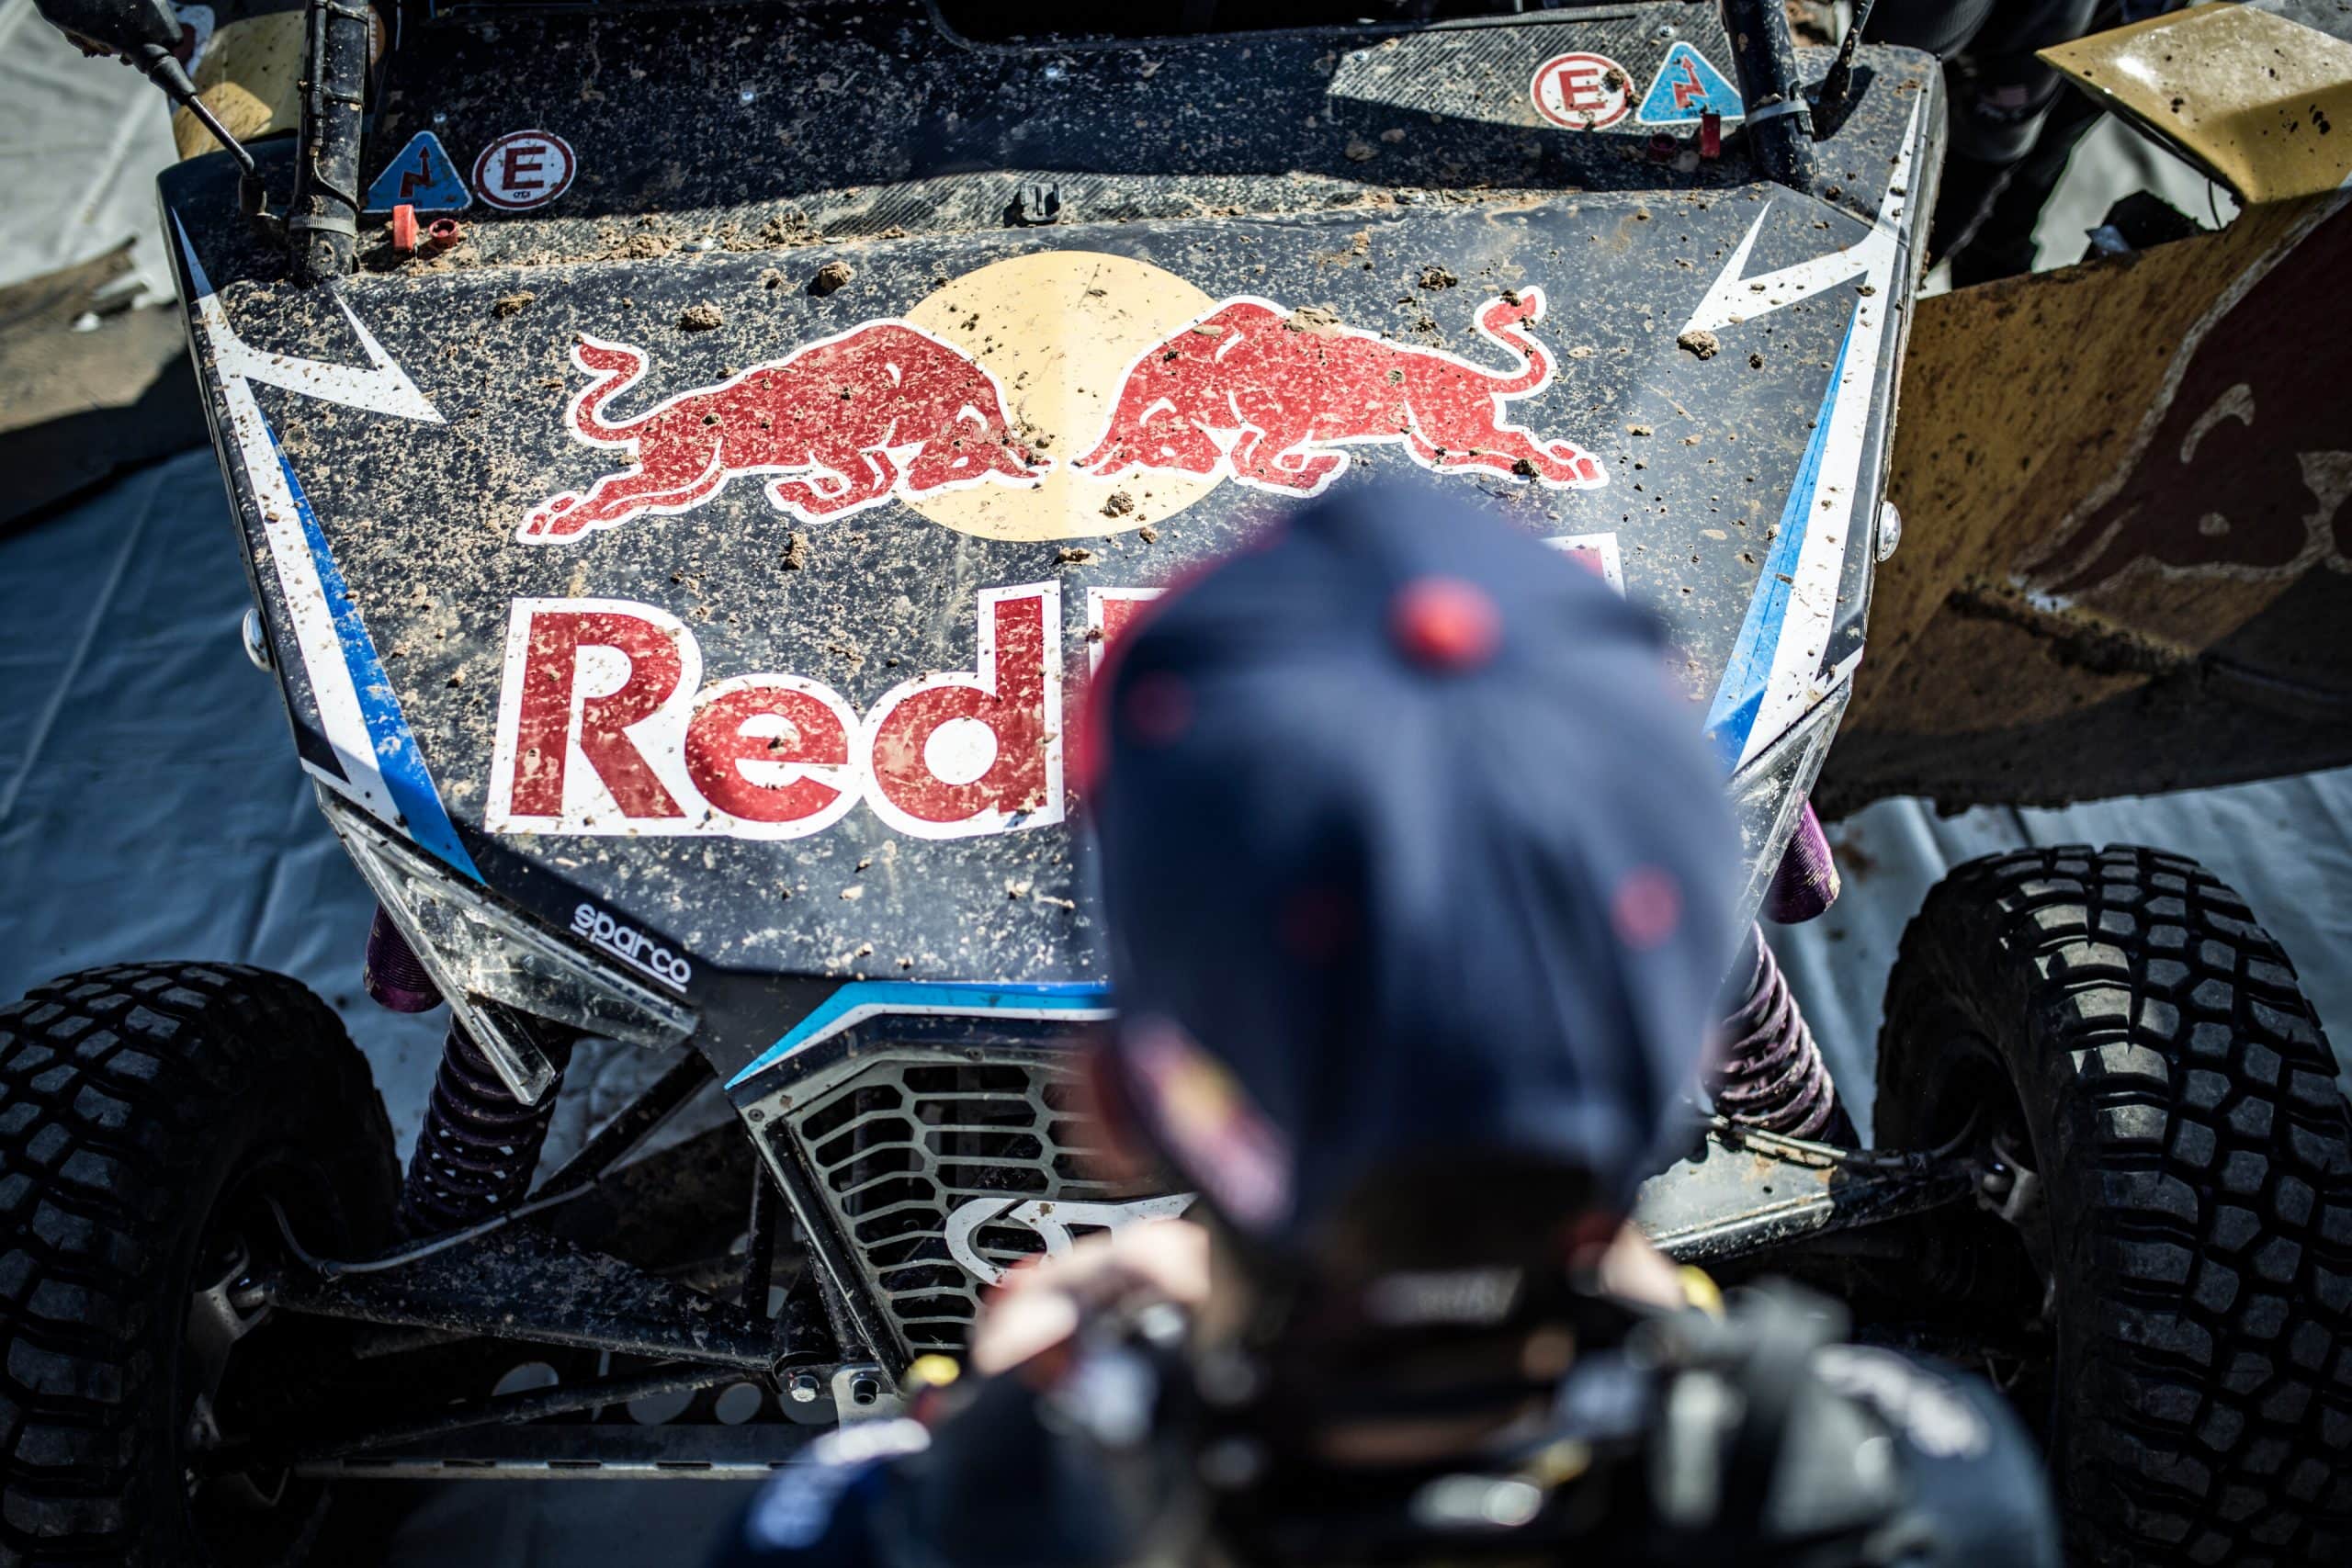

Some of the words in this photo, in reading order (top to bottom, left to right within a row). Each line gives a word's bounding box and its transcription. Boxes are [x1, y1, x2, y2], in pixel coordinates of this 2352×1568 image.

[1558, 69, 1607, 111] E
[502, 146, 547, 191] E
[489, 582, 1063, 837] Red
[571, 903, 691, 990] sparco
